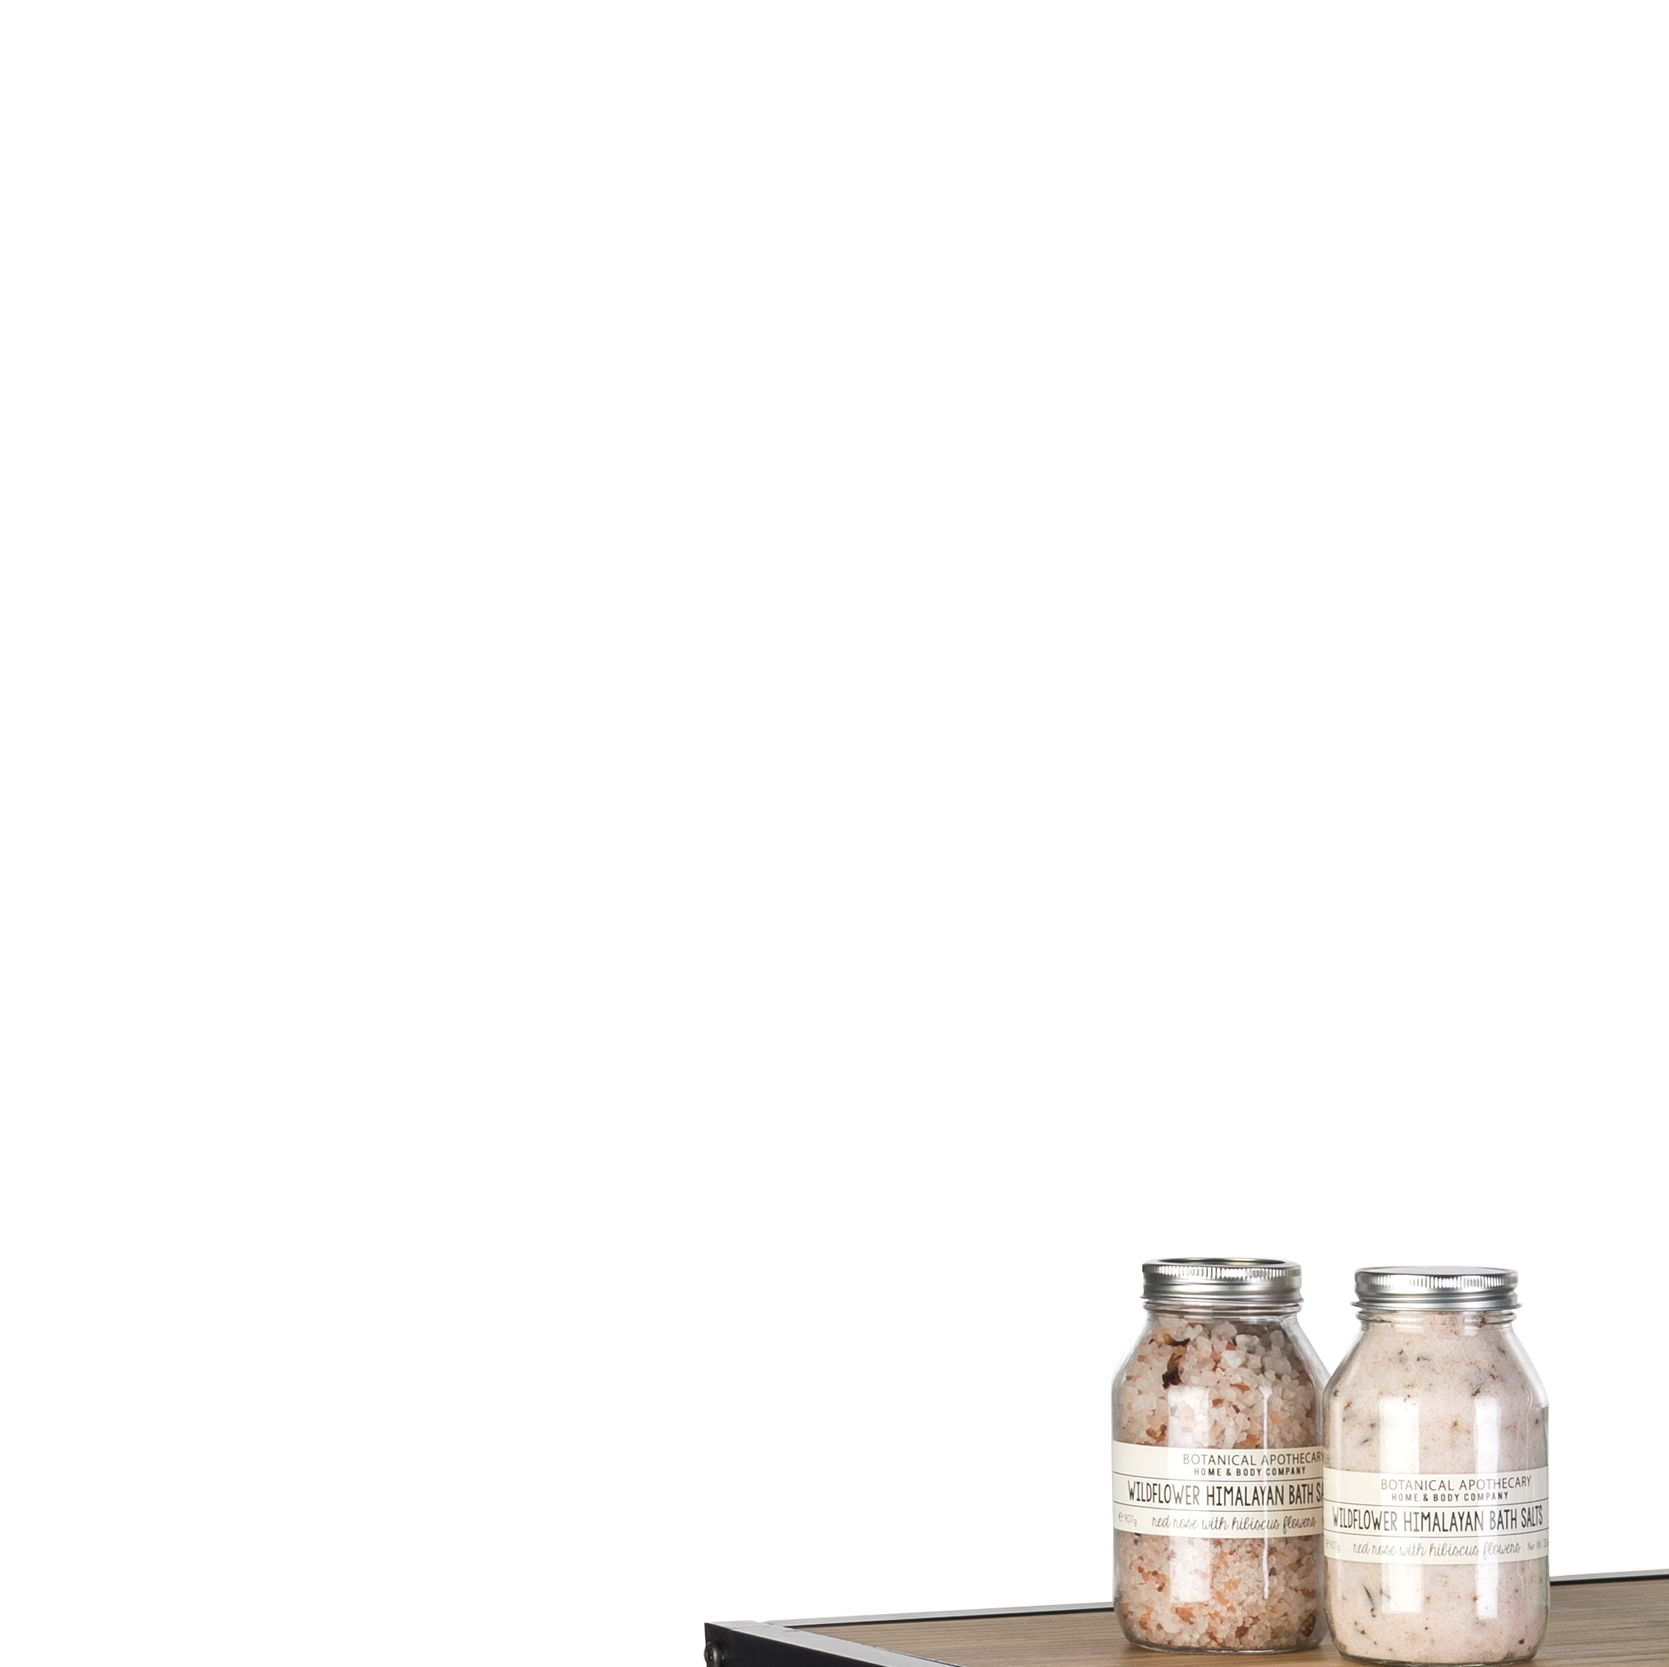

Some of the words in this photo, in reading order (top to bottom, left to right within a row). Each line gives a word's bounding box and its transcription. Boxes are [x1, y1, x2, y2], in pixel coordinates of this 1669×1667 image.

[1183, 1454, 1256, 1465] BOTANICAL
[1194, 1468, 1222, 1476] HOME
[1236, 1468, 1261, 1476] BODY
[1265, 1467, 1306, 1476] COMPANY
[1381, 1479, 1454, 1491] BOTANICAL
[1458, 1476, 1532, 1491] APOTHECARY
[1127, 1480, 1200, 1505] WILDFLOWER
[1206, 1485, 1284, 1507] HIMALAYAN
[1289, 1483, 1314, 1506] BATH
[1391, 1493, 1418, 1502] HOME
[1433, 1493, 1460, 1502] BODY
[1464, 1491, 1508, 1501] COMPANY
[1152, 1516, 1169, 1529] red
[1173, 1517, 1199, 1530] rose
[1202, 1517, 1228, 1530] with
[1232, 1517, 1280, 1531] hibiscus
[1283, 1515, 1316, 1535] flowers
[1332, 1507, 1398, 1532] WILDFLOWER
[1403, 1511, 1483, 1532] HIMALAYAN
[1489, 1509, 1517, 1531] BATH
[1521, 1505, 1543, 1528] SALTS
[1352, 1541, 1370, 1555] red
[1372, 1543, 1397, 1556] rose
[1399, 1542, 1426, 1557] with
[1428, 1542, 1479, 1557] hibiscus
[1482, 1539, 1521, 1560] flowers
